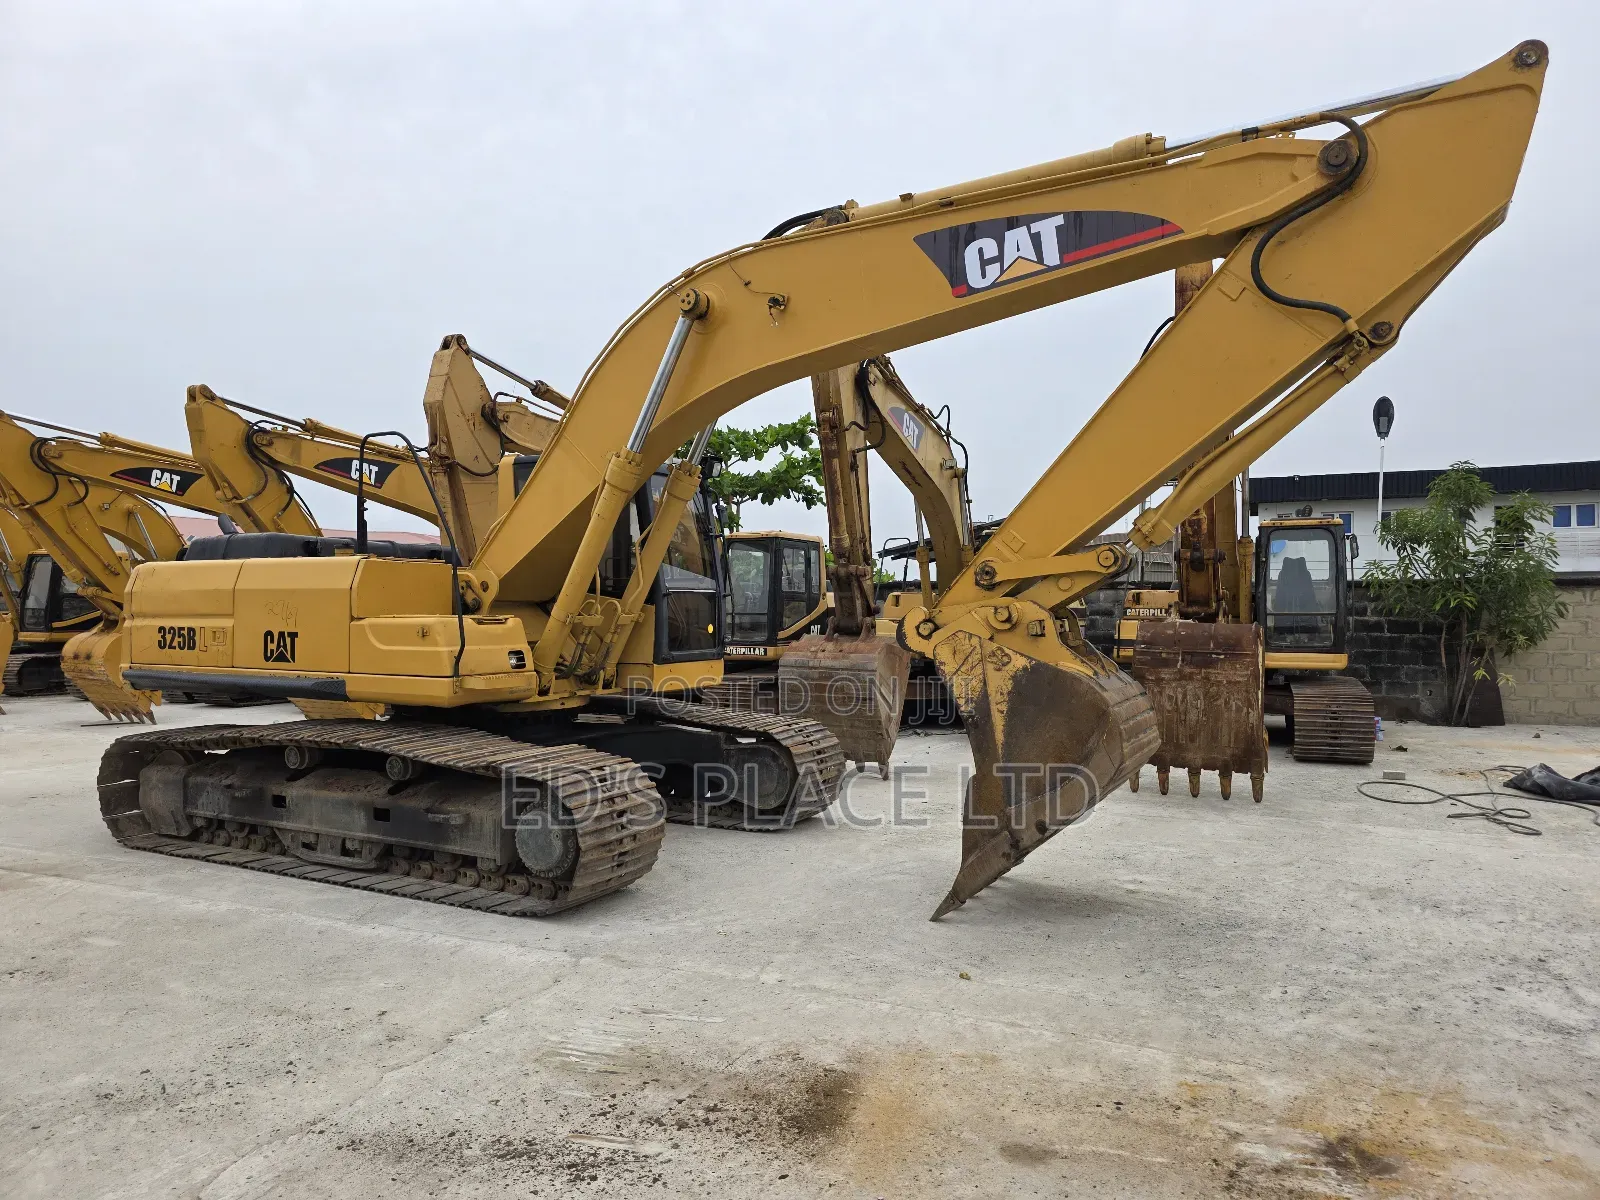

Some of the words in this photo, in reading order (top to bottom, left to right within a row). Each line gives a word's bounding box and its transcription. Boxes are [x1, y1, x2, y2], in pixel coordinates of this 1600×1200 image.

[964, 213, 1065, 289] CAT
[903, 412, 919, 450] CAT
[150, 469, 180, 493] CAT
[350, 459, 379, 486] CAT
[1126, 608, 1168, 617] CATERPILL
[810, 624, 821, 635] CAT
[263, 629, 299, 663] CAT
[724, 646, 765, 656] ATERPILLAR
